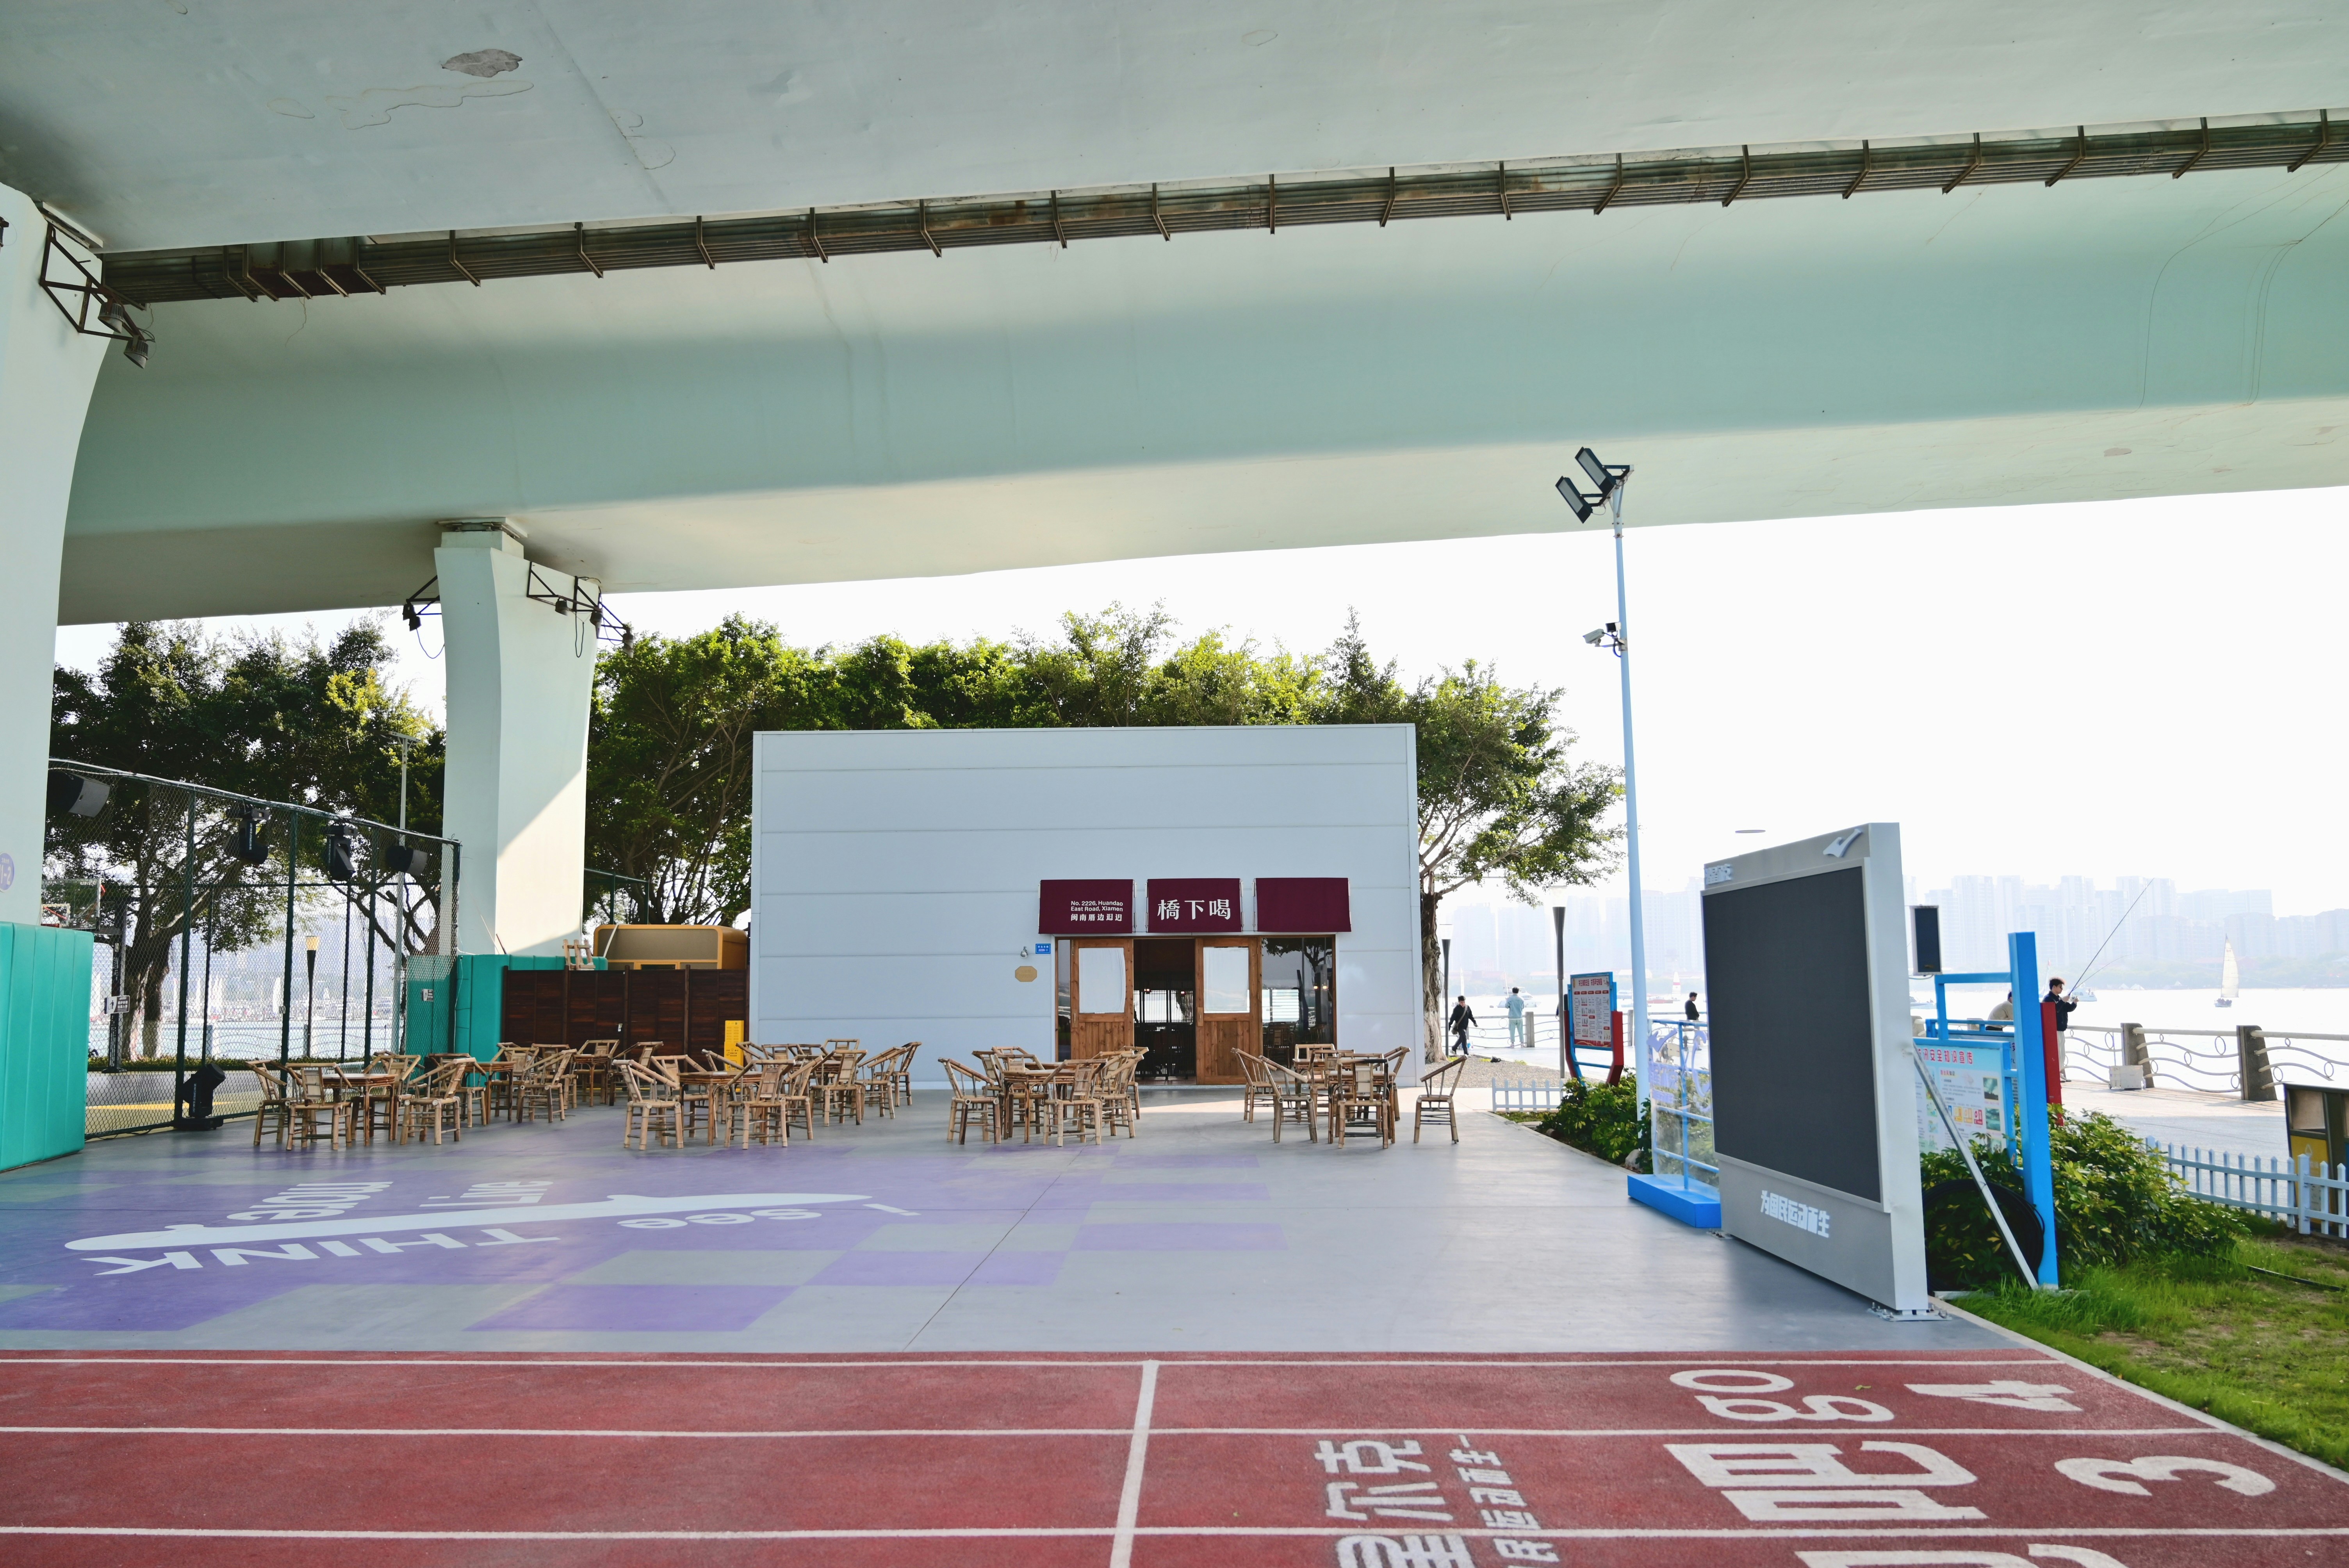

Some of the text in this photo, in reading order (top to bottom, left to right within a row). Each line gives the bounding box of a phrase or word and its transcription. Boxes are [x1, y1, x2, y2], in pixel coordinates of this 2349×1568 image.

[1157, 899, 1231, 920] 橋下喝
[226, 1181, 393, 1221] more
[617, 1208, 822, 1229] see
[1760, 1190, 1830, 1238] 为国民运动而生
[80, 1228, 561, 1276] THINK
[1669, 1369, 1895, 1422] go
[1904, 1380, 2083, 1411] 4
[2054, 1456, 2276, 1496] 3
[1449, 1449, 1559, 1568] 民运动而生
